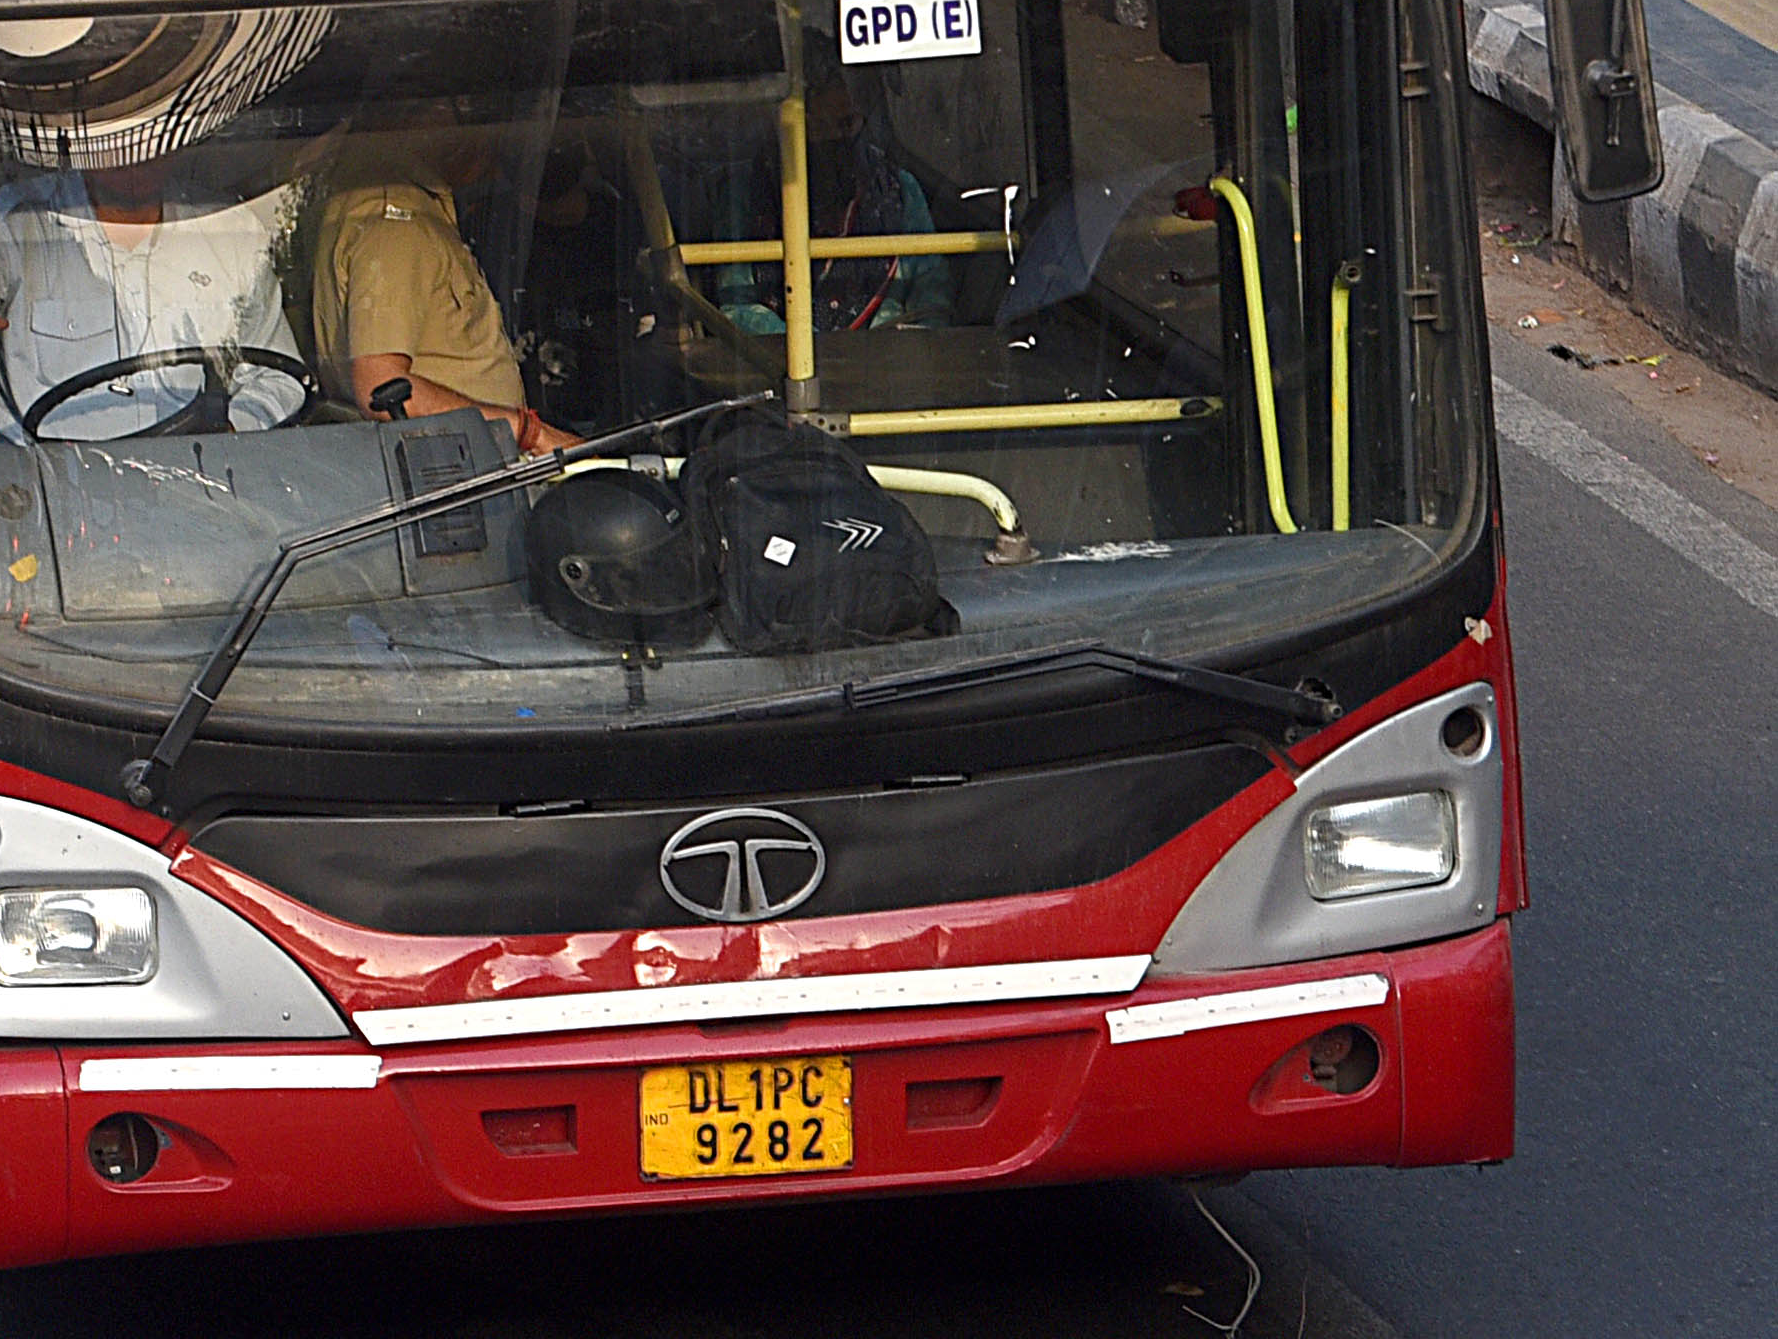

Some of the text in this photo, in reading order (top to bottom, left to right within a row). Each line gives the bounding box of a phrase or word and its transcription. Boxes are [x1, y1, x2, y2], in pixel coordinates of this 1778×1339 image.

[845, 3, 918, 47] GPD
[645, 1112, 669, 1126] IND
[696, 1117, 825, 1165] 9282
